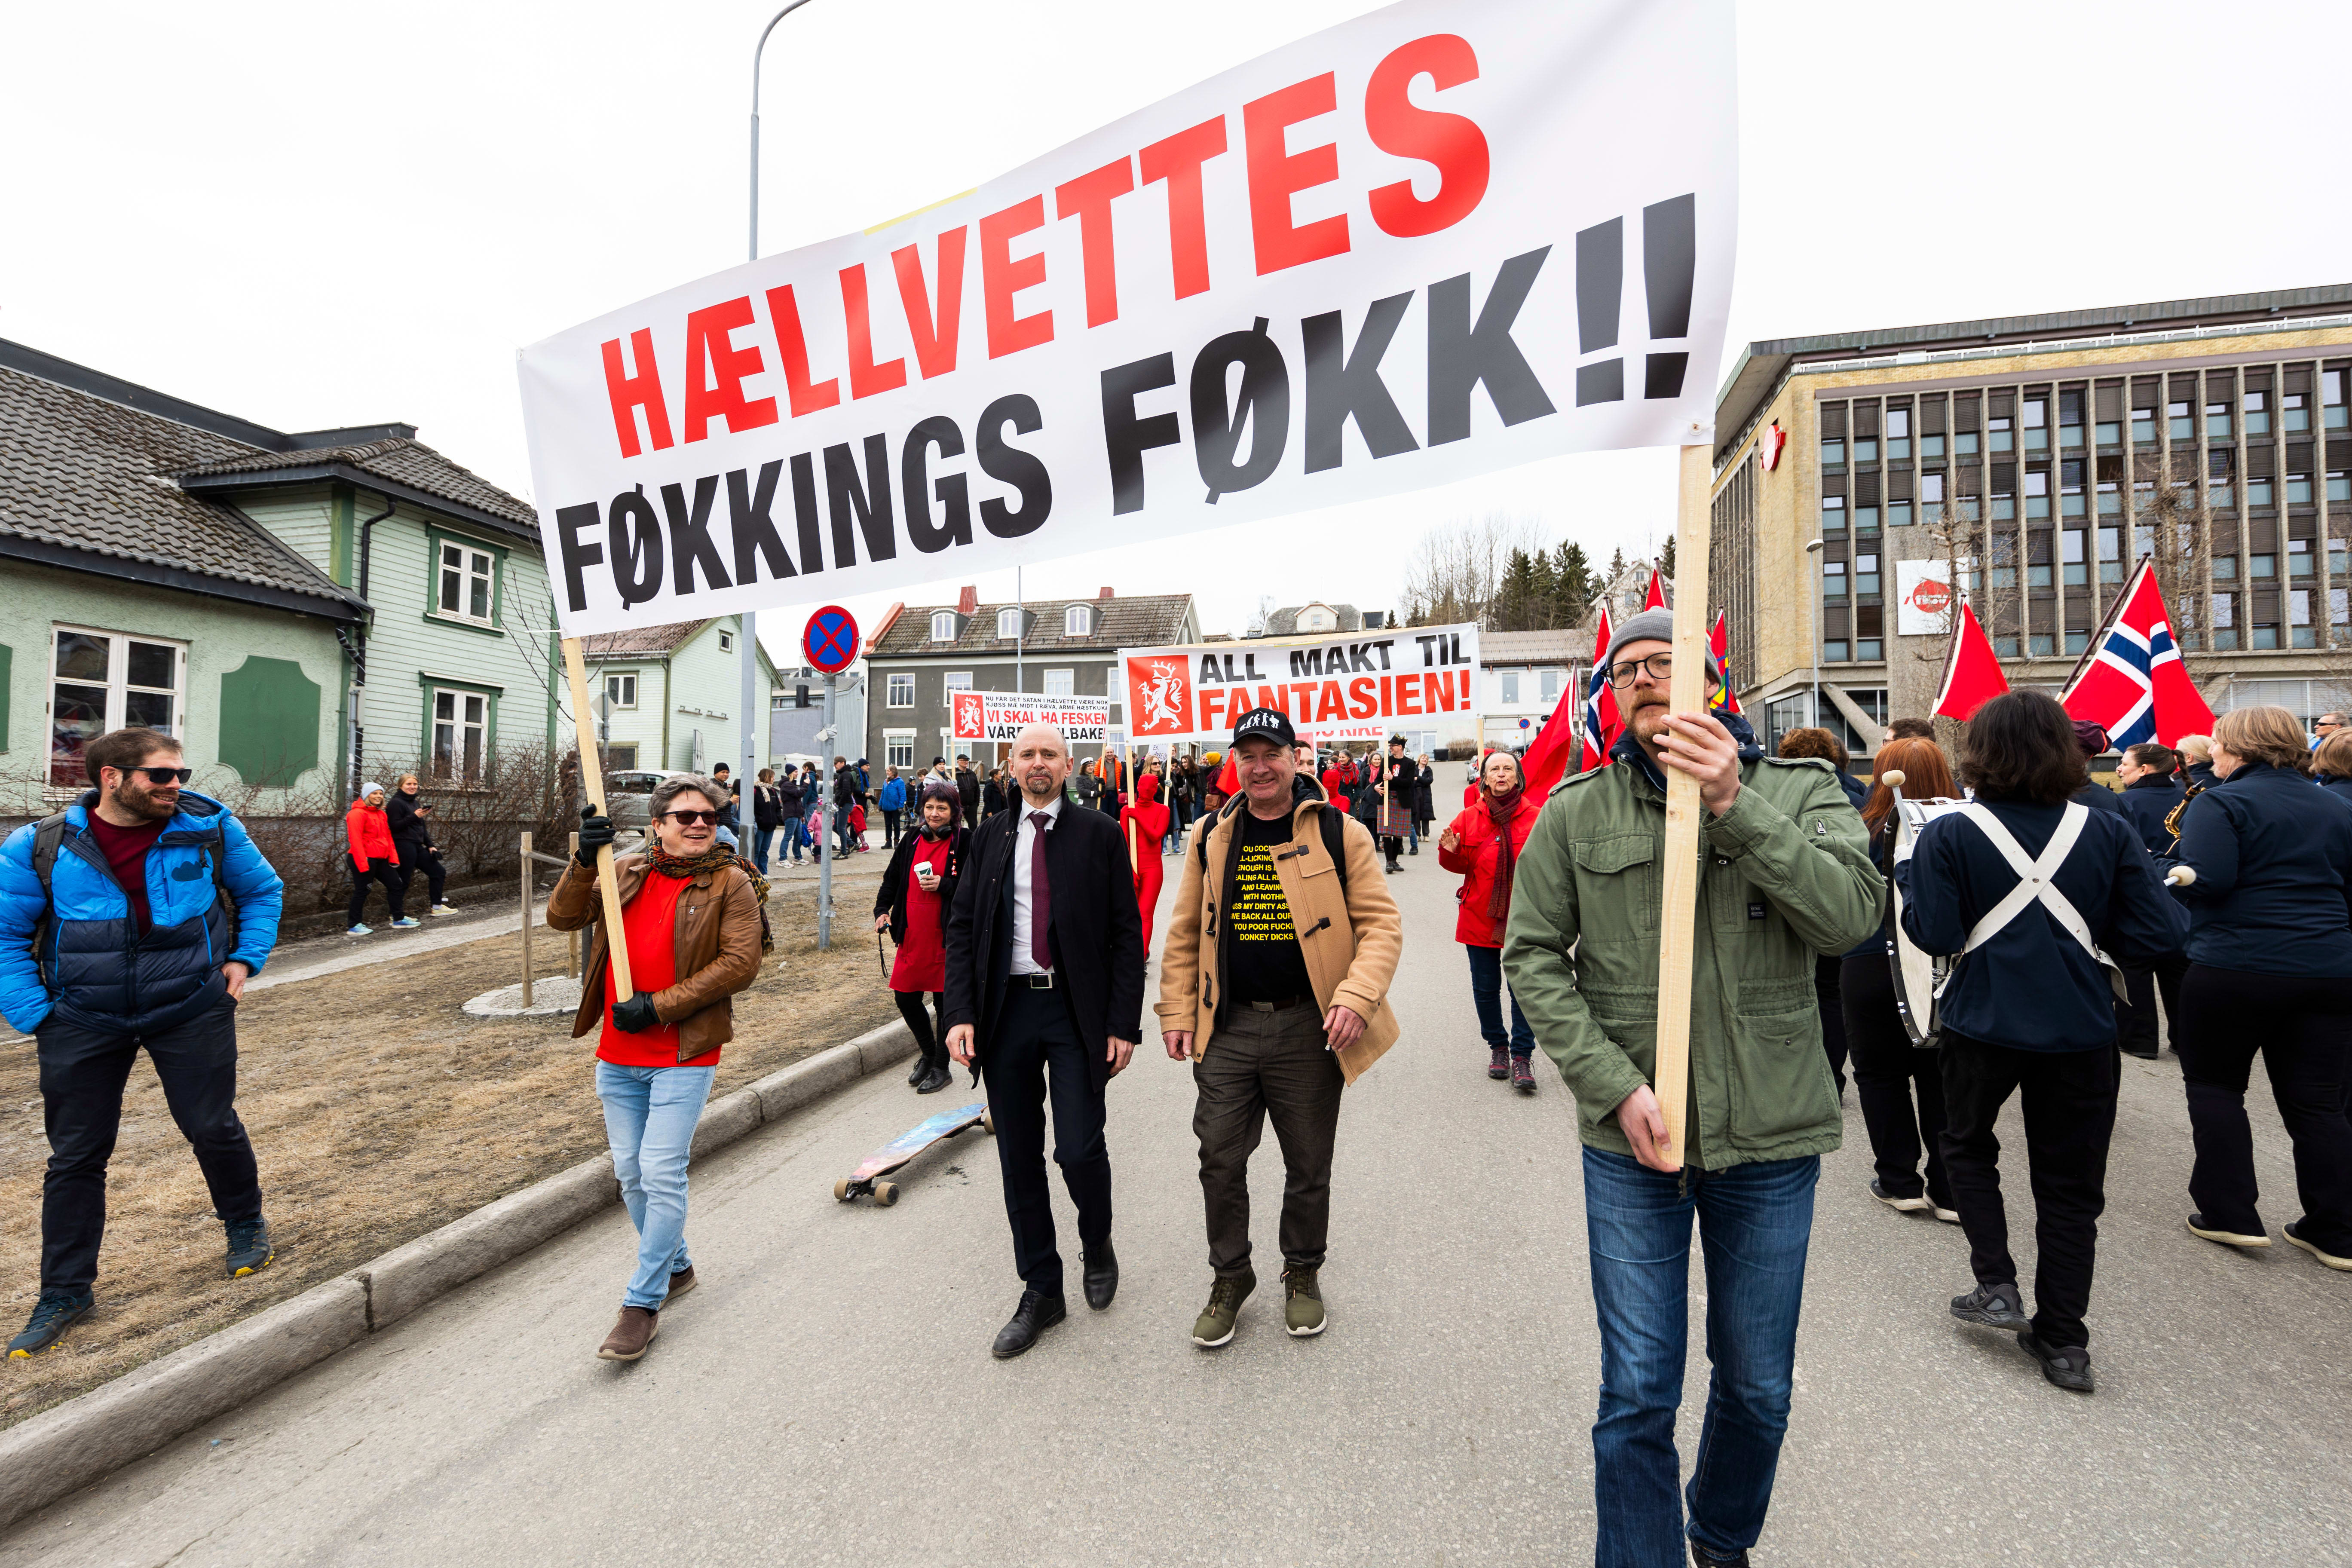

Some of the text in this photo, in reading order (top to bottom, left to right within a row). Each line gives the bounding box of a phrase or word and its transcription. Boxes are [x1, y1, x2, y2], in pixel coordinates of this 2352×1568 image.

[601, 34, 1490, 459] HÆLLVETTES
[555, 193, 1695, 612] FØKKINGS FØKK!!
[1198, 633, 1471, 684] ALL MAKT TIL
[987, 710, 1107, 725] VI SKAL HA FESKEN
[1198, 669, 1471, 731] FANTASIEN!
[1056, 728, 1106, 740] LBAKE!
